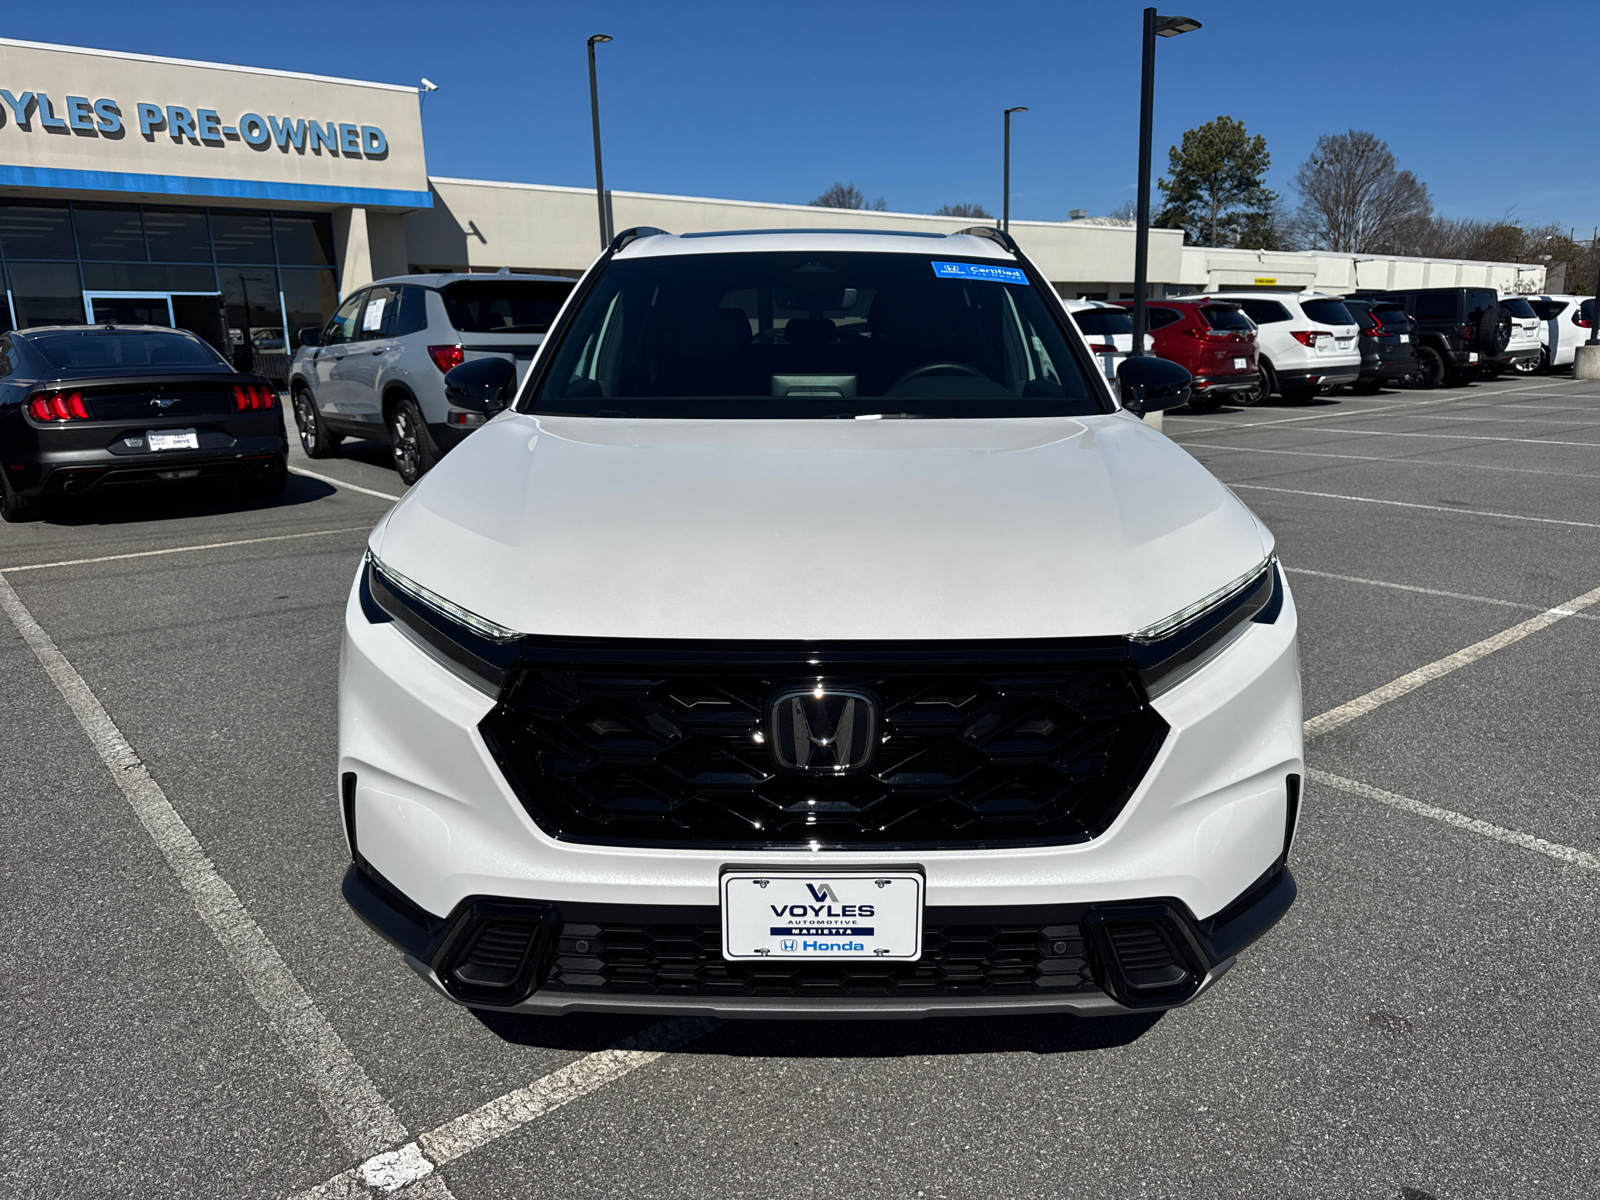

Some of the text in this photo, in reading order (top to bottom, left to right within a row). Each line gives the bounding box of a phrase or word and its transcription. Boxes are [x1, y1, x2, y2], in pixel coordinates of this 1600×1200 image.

[0, 89, 388, 156] YLES PRE-OWNED
[970, 266, 1020, 277] Certified
[770, 904, 875, 918] VOYLES
[802, 940, 865, 951] Honda
